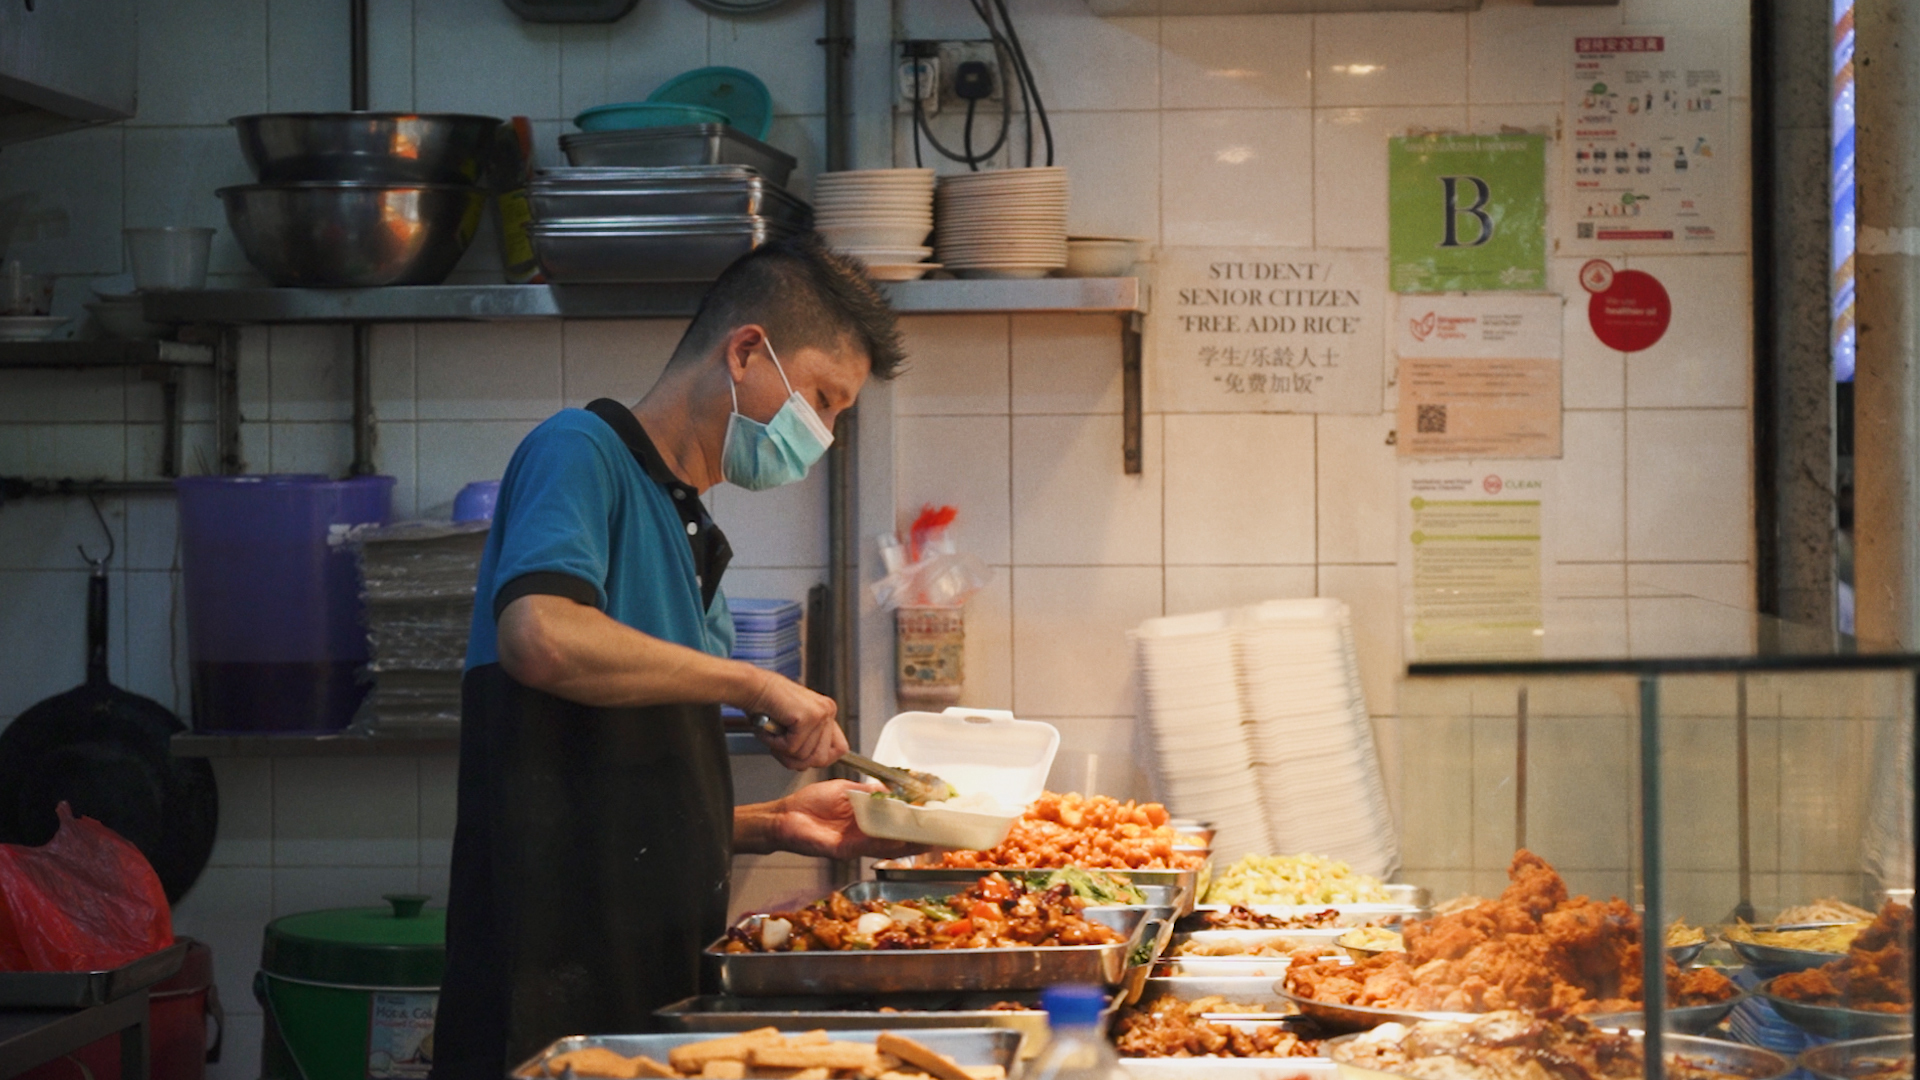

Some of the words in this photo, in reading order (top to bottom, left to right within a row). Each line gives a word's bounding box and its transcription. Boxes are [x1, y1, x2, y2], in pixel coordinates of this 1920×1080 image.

[1436, 176, 1493, 248] B
[1209, 262, 1319, 280] STUDENT
[1178, 288, 1263, 307] SENIOR
[1269, 288, 1361, 307] CITIZEN
[1246, 315, 1297, 333] ADD
[1199, 347, 1341, 369] 学生/乐龄人士
[1504, 480, 1542, 489] CLEAN
